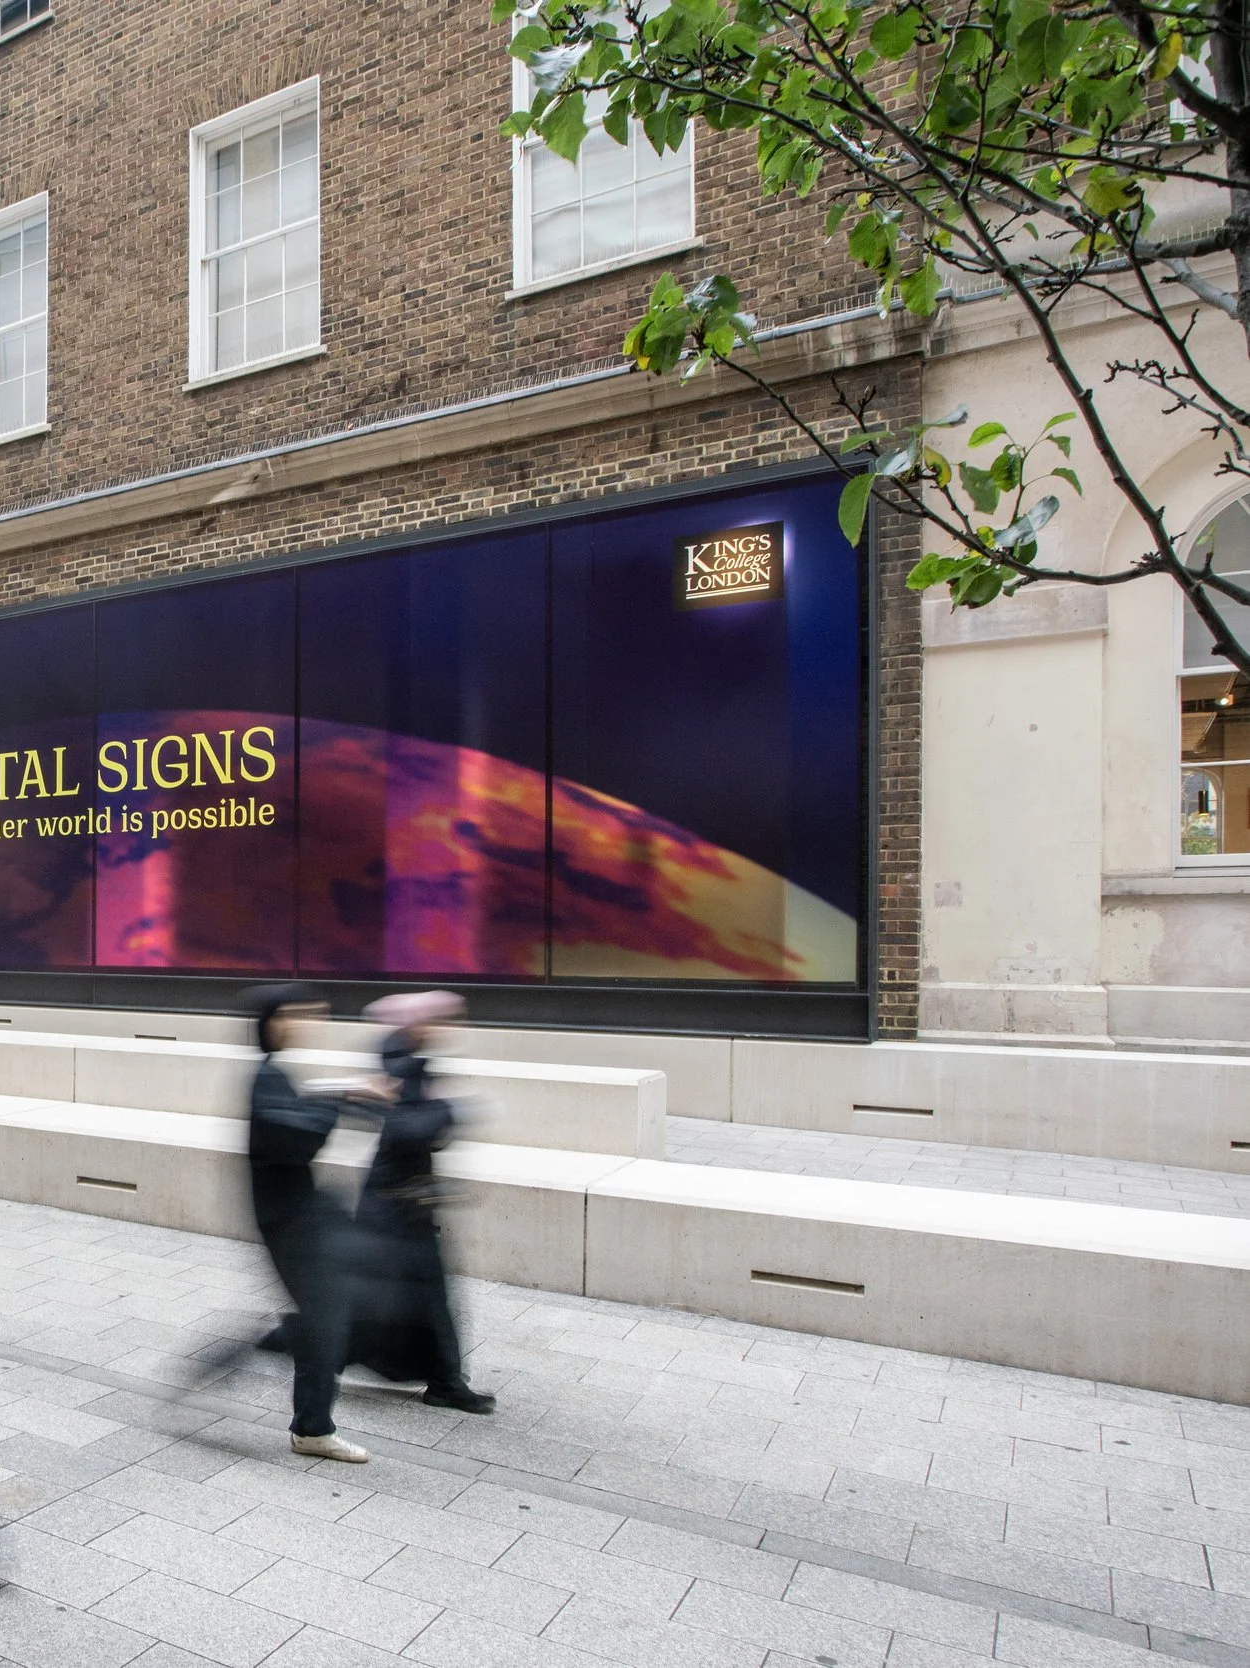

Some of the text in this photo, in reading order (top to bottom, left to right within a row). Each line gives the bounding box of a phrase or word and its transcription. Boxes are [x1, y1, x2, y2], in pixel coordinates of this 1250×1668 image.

[684, 533, 772, 576] KING'S
[713, 552, 771, 571] College
[685, 566, 772, 592] LONDON
[97, 726, 277, 794] SIGNS
[35, 806, 112, 838] world
[121, 805, 143, 832] is
[151, 797, 275, 839] possible
